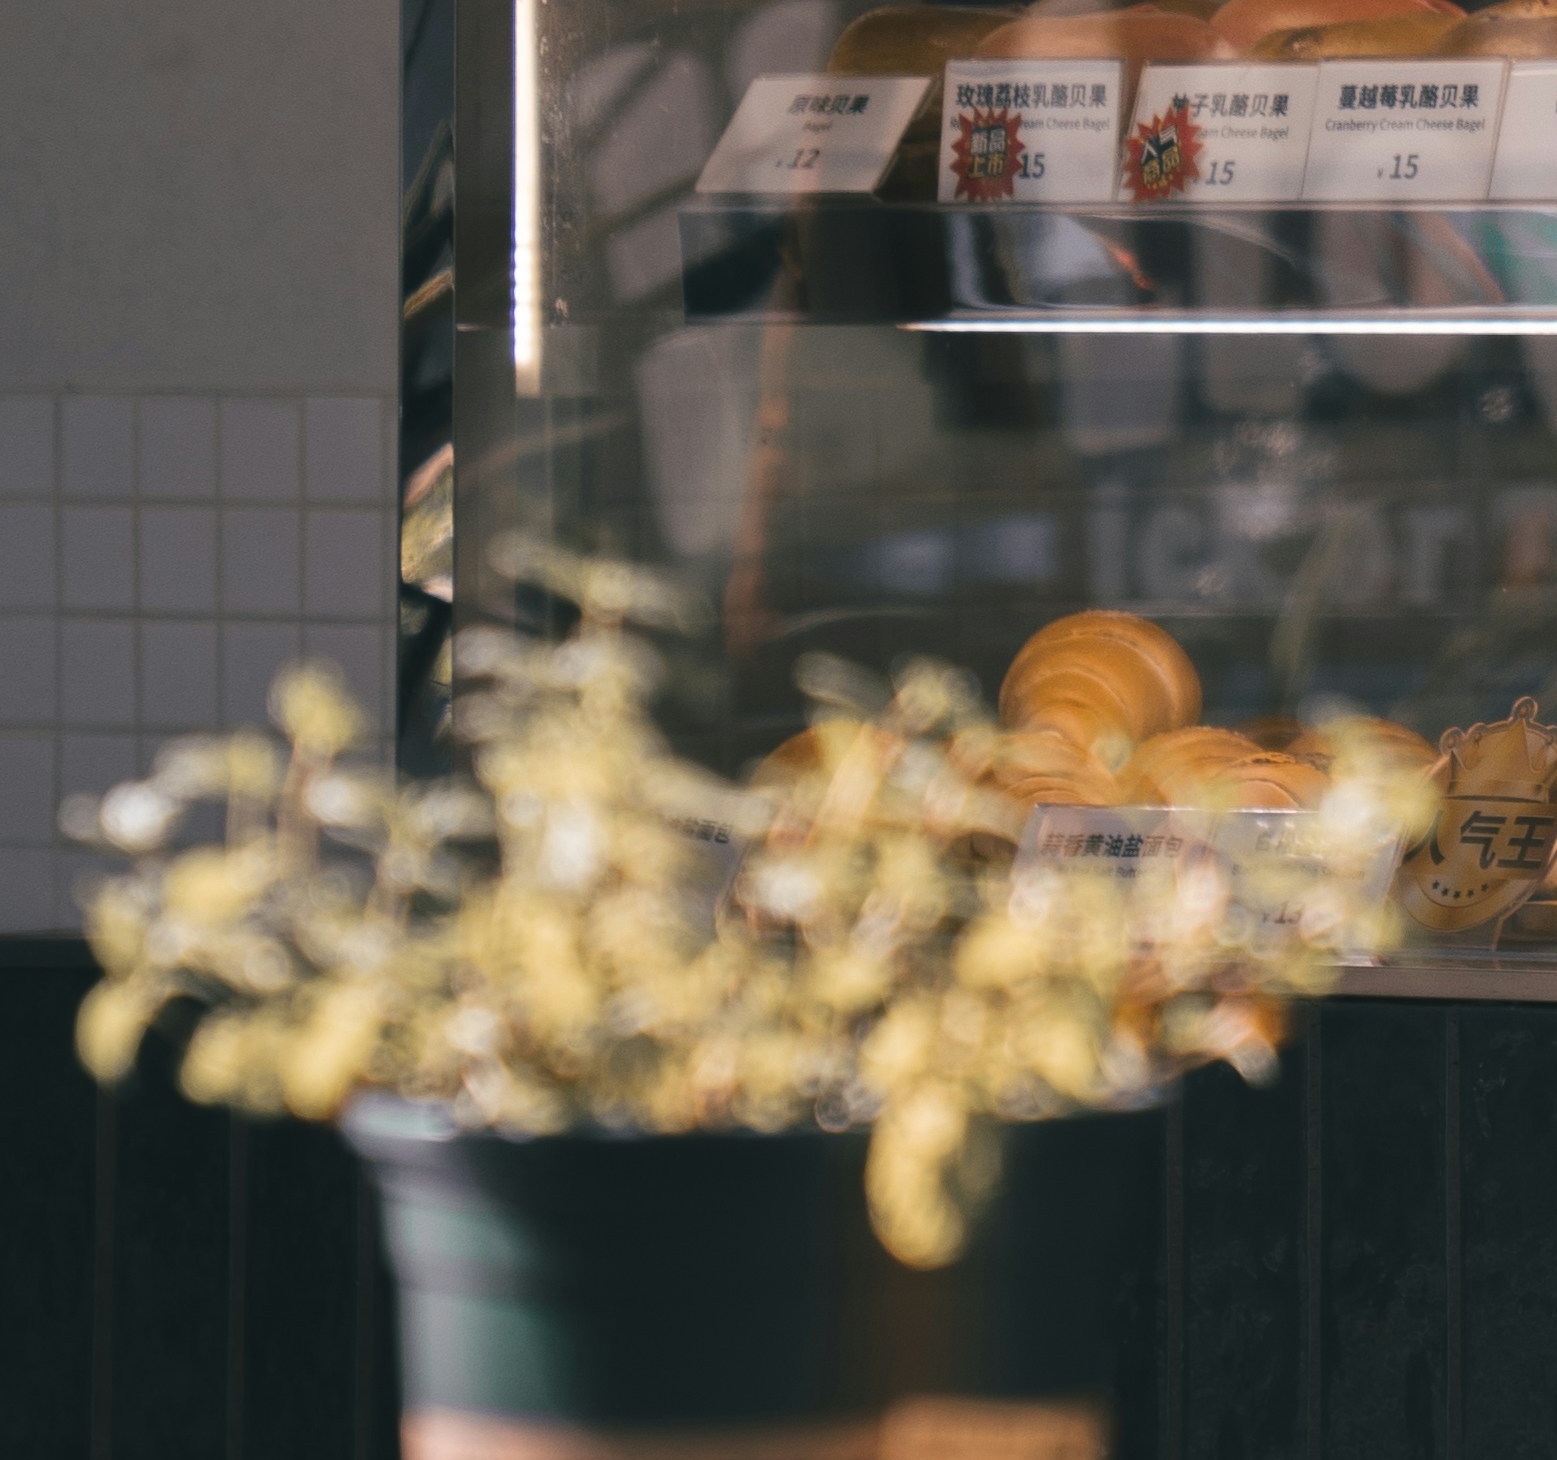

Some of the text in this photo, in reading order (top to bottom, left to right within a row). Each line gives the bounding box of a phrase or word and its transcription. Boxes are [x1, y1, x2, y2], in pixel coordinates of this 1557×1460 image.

[956, 82, 1107, 108] 玫瑰荔枝乳酪贝果
[1339, 85, 1479, 109] 蔓越莓乳酪贝果
[1047, 117, 1110, 131] Cheese Bagel
[1326, 119, 1485, 133] Cranberry Cream Cheese Bagel
[1402, 810, 1555, 869] 人气王
